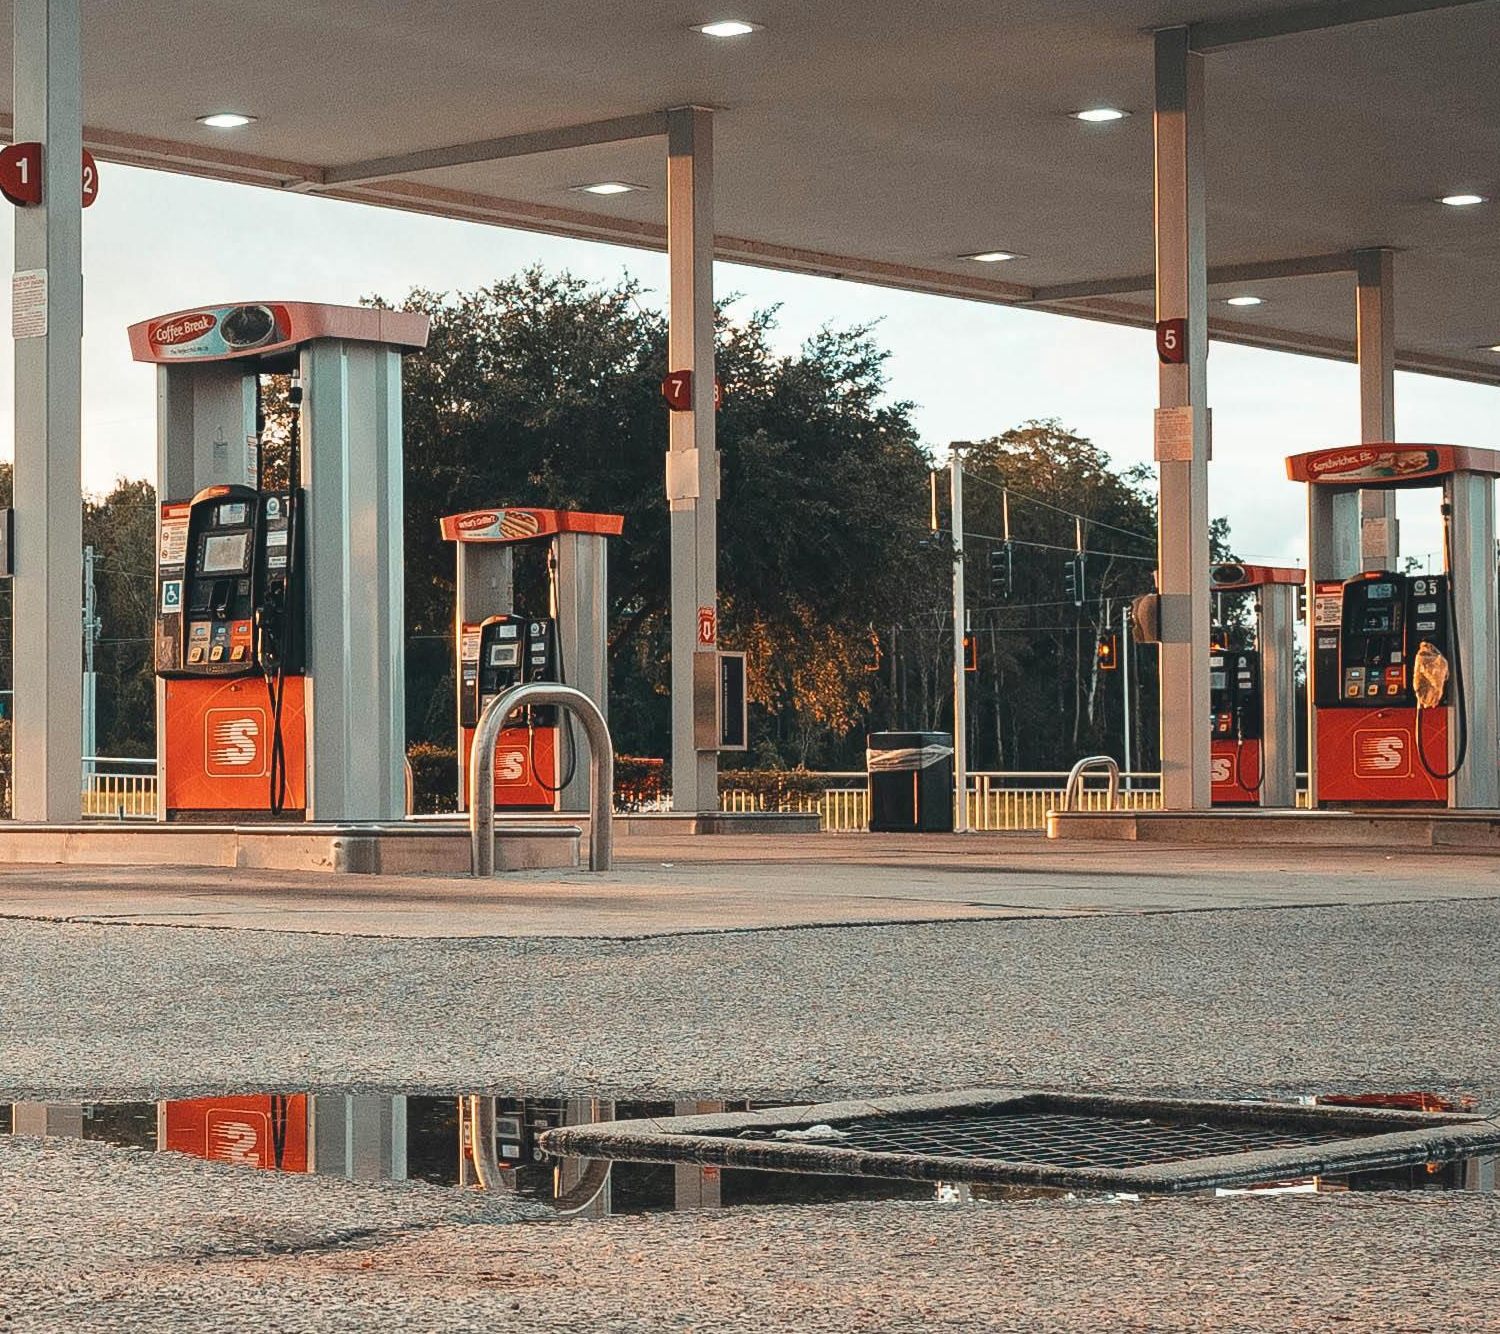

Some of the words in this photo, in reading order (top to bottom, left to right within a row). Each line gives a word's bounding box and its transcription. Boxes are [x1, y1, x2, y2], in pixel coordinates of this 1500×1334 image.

[15, 157, 28, 184] 1
[83, 167, 93, 194] 2
[156, 325, 184, 343] Coffee
[184, 316, 210, 334] Break
[1164, 329, 1177, 349] 5
[671, 379, 683, 398] 7
[1429, 582, 1437, 595] 5
[540, 624, 547, 635] 7
[209, 718, 259, 766] S
[1359, 736, 1404, 770] S
[495, 751, 524, 780] S
